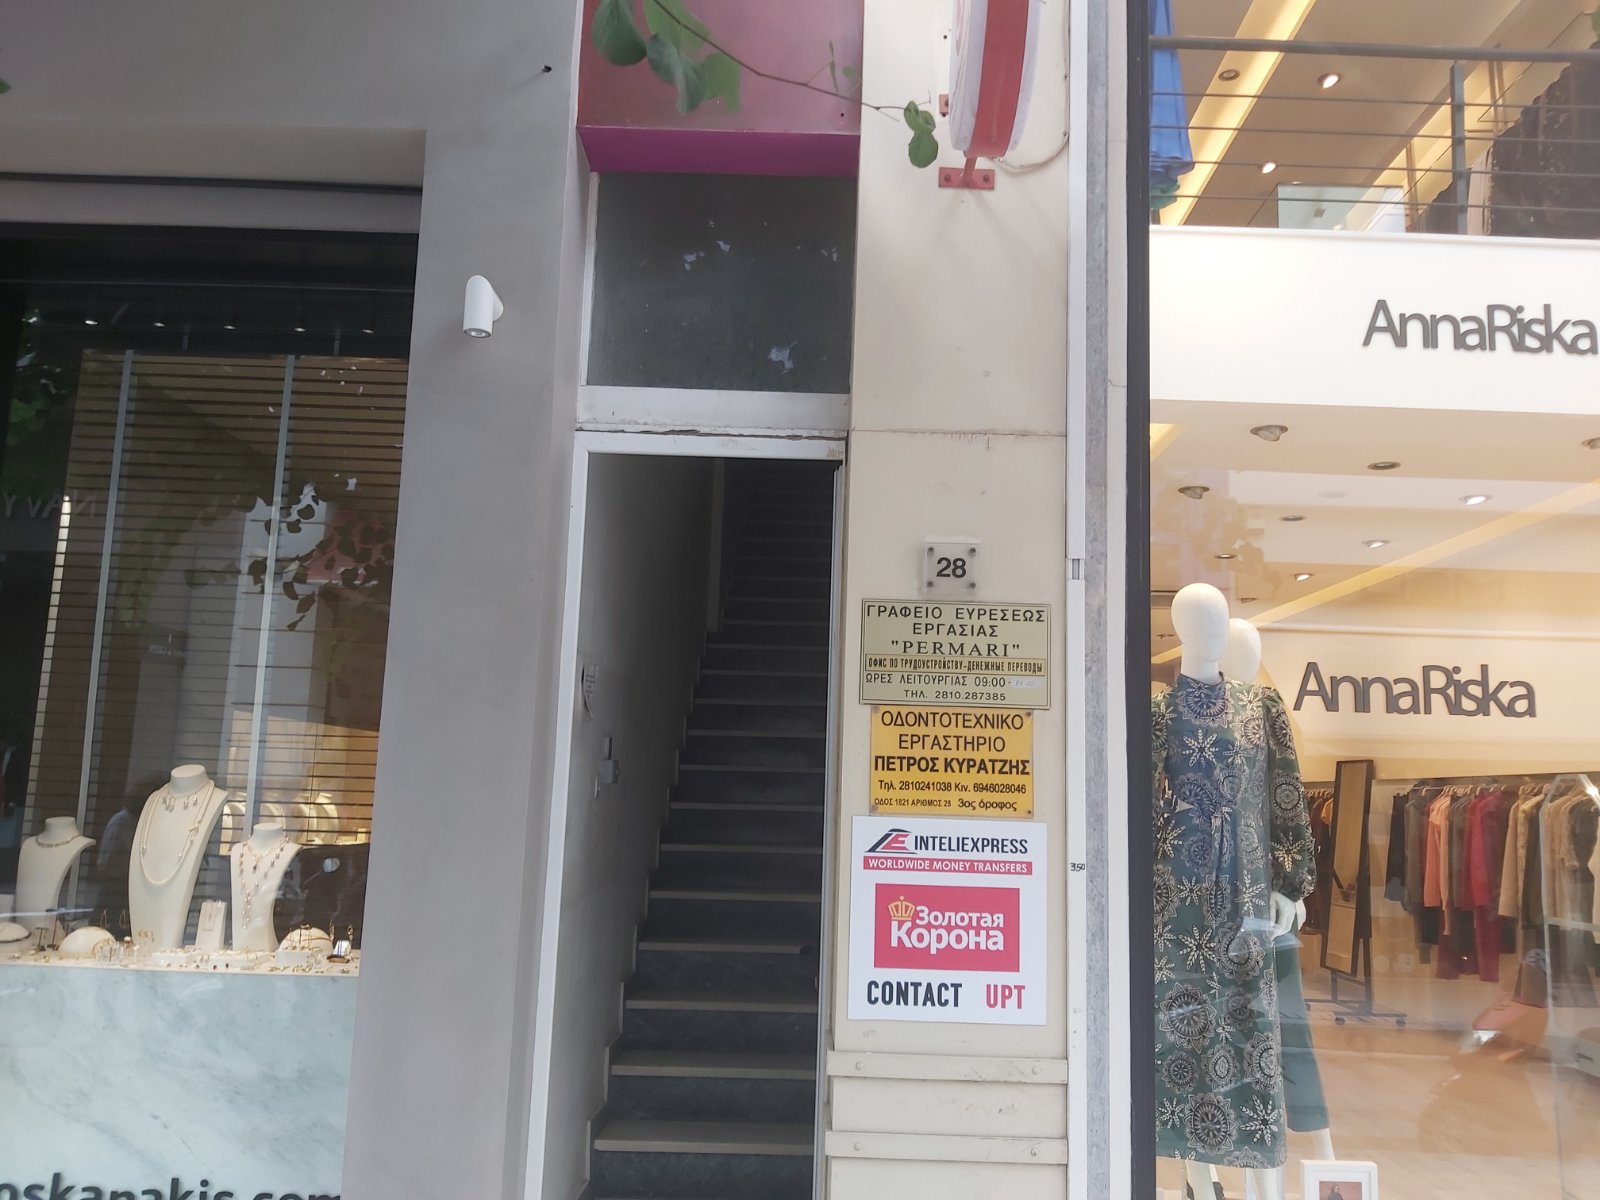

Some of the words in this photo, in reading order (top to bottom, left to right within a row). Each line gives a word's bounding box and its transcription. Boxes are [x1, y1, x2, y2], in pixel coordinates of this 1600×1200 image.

[1362, 298, 1599, 355] AnnaRiska
[936, 557, 967, 578] 28
[867, 605, 942, 619] ΓΡΑΦΕΙΟ
[955, 608, 1045, 622] ΕΥΡΕΣΕΩΣ
[913, 623, 998, 637] ΕΡΓΑΣΙΑΣ
[891, 640, 1020, 657] "PERMARI"
[868, 657, 887, 668] ОФИС
[890, 658, 898, 668] ПО
[1007, 662, 1042, 674] ПЕРЕВОДЫ
[866, 673, 893, 683] ΩΡΕΣ
[899, 674, 967, 686] ΛΕΙΤΟΥΡΓΙΑΣ
[904, 689, 928, 698] ΤΗΛ.
[935, 690, 1006, 700] 2810.287385
[1293, 661, 1537, 718] AnnaRiska
[881, 710, 1024, 730] ΟΔΟΝΤΟΤΕΧΝΙΚΟ
[899, 734, 1006, 752] ΕΡΓΑΣΤΗΡΙΟ
[874, 755, 939, 773] ΠΕΤΡΟΣ
[944, 758, 1030, 775] ΚΥΡΑΤΖΗΣ
[878, 780, 896, 793] Τηλ.
[898, 780, 951, 792] 2810241038
[954, 782, 971, 792] Κιν.
[973, 782, 1027, 794] 6946028046
[874, 798, 893, 806] ΟΔΟΣ
[911, 799, 942, 807] ΑΡΙΘΜΟΣ
[958, 798, 976, 810] 3ος
[979, 799, 1017, 812] όροφος
[914, 835, 1028, 854] INTELIEXPRESS
[868, 858, 930, 870] WORLDWIDE
[932, 860, 970, 872] MONEY
[973, 862, 1027, 873] TRANSFERS
[915, 906, 1004, 928] Золотая
[890, 920, 1004, 955] Корона
[867, 980, 962, 1007] CONTACT
[986, 984, 1025, 1009] UPT
